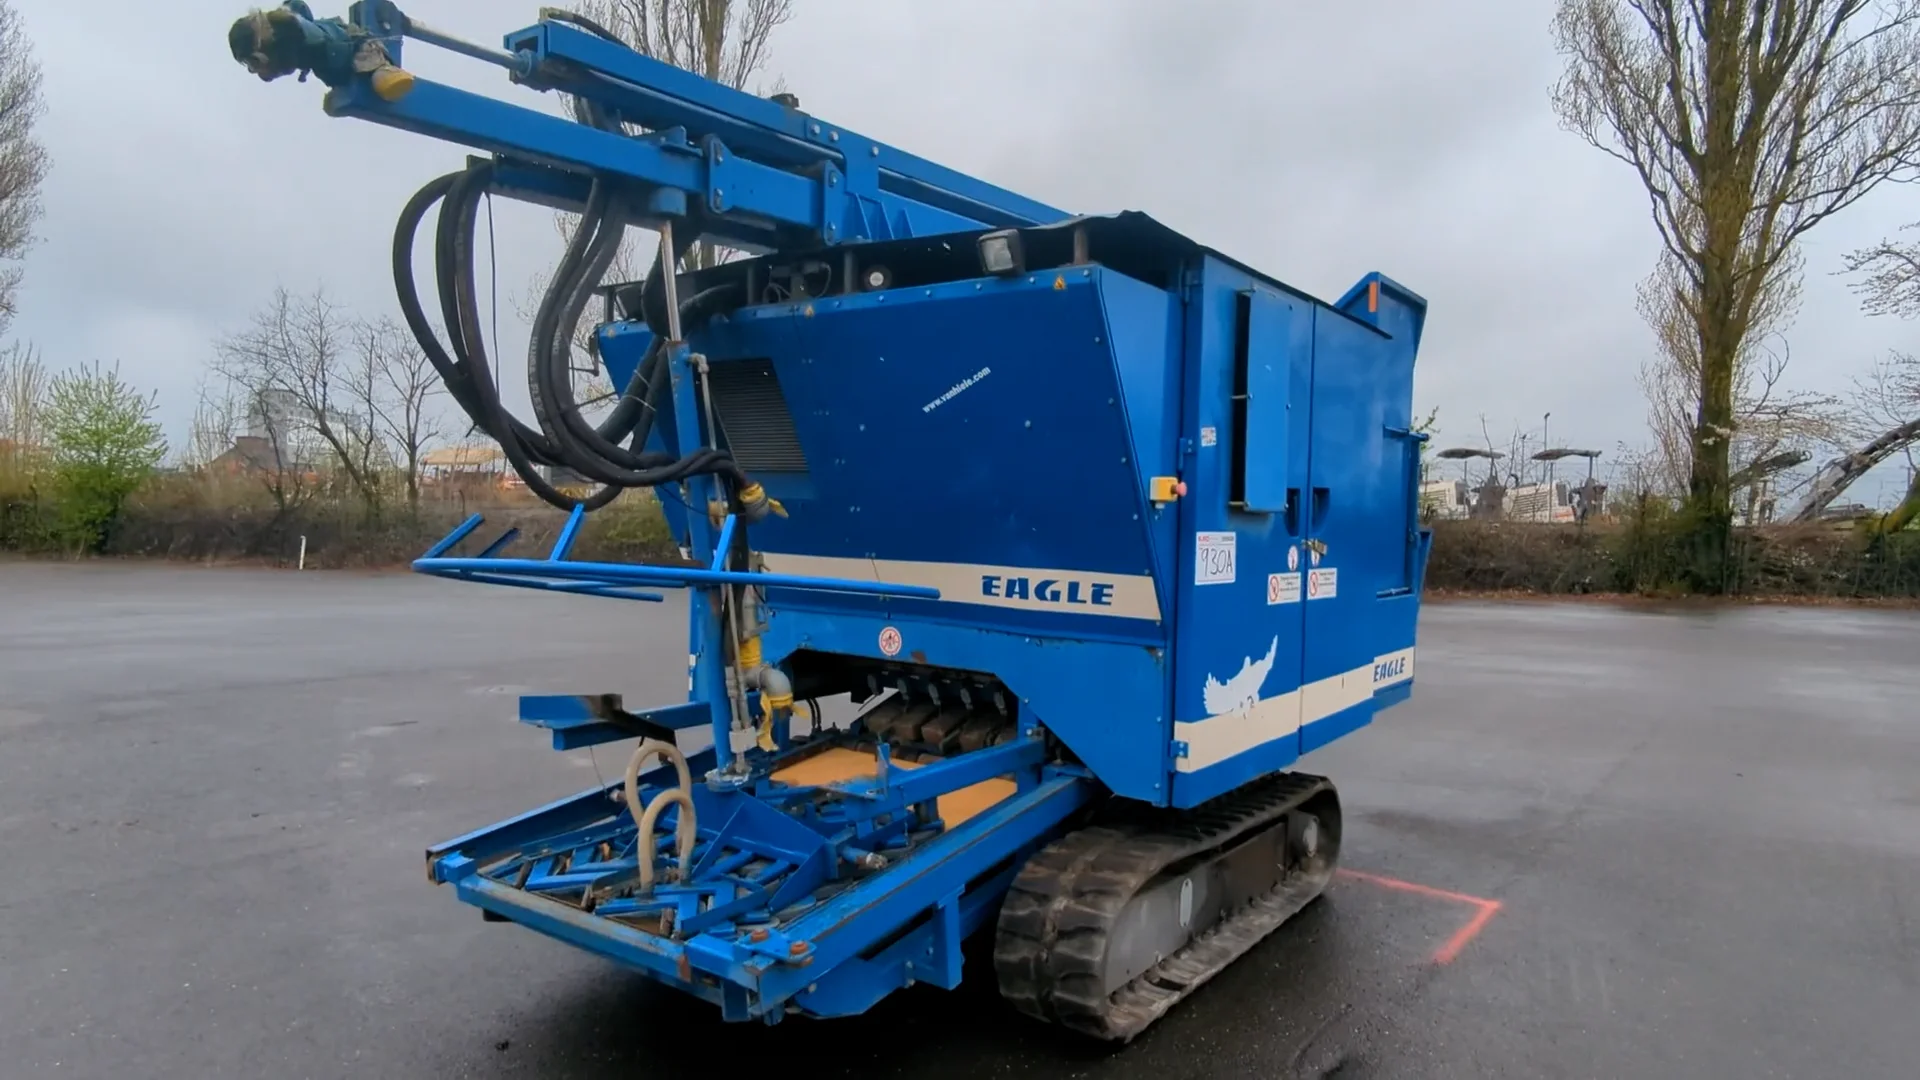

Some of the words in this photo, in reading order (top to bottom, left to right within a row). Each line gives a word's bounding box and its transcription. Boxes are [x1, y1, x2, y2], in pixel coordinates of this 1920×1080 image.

[922, 366, 991, 413] www.vanhiele.com
[1201, 547, 1233, 577] 930A
[982, 575, 1114, 606] EAGLE
[1373, 656, 1405, 683] EAGLE
